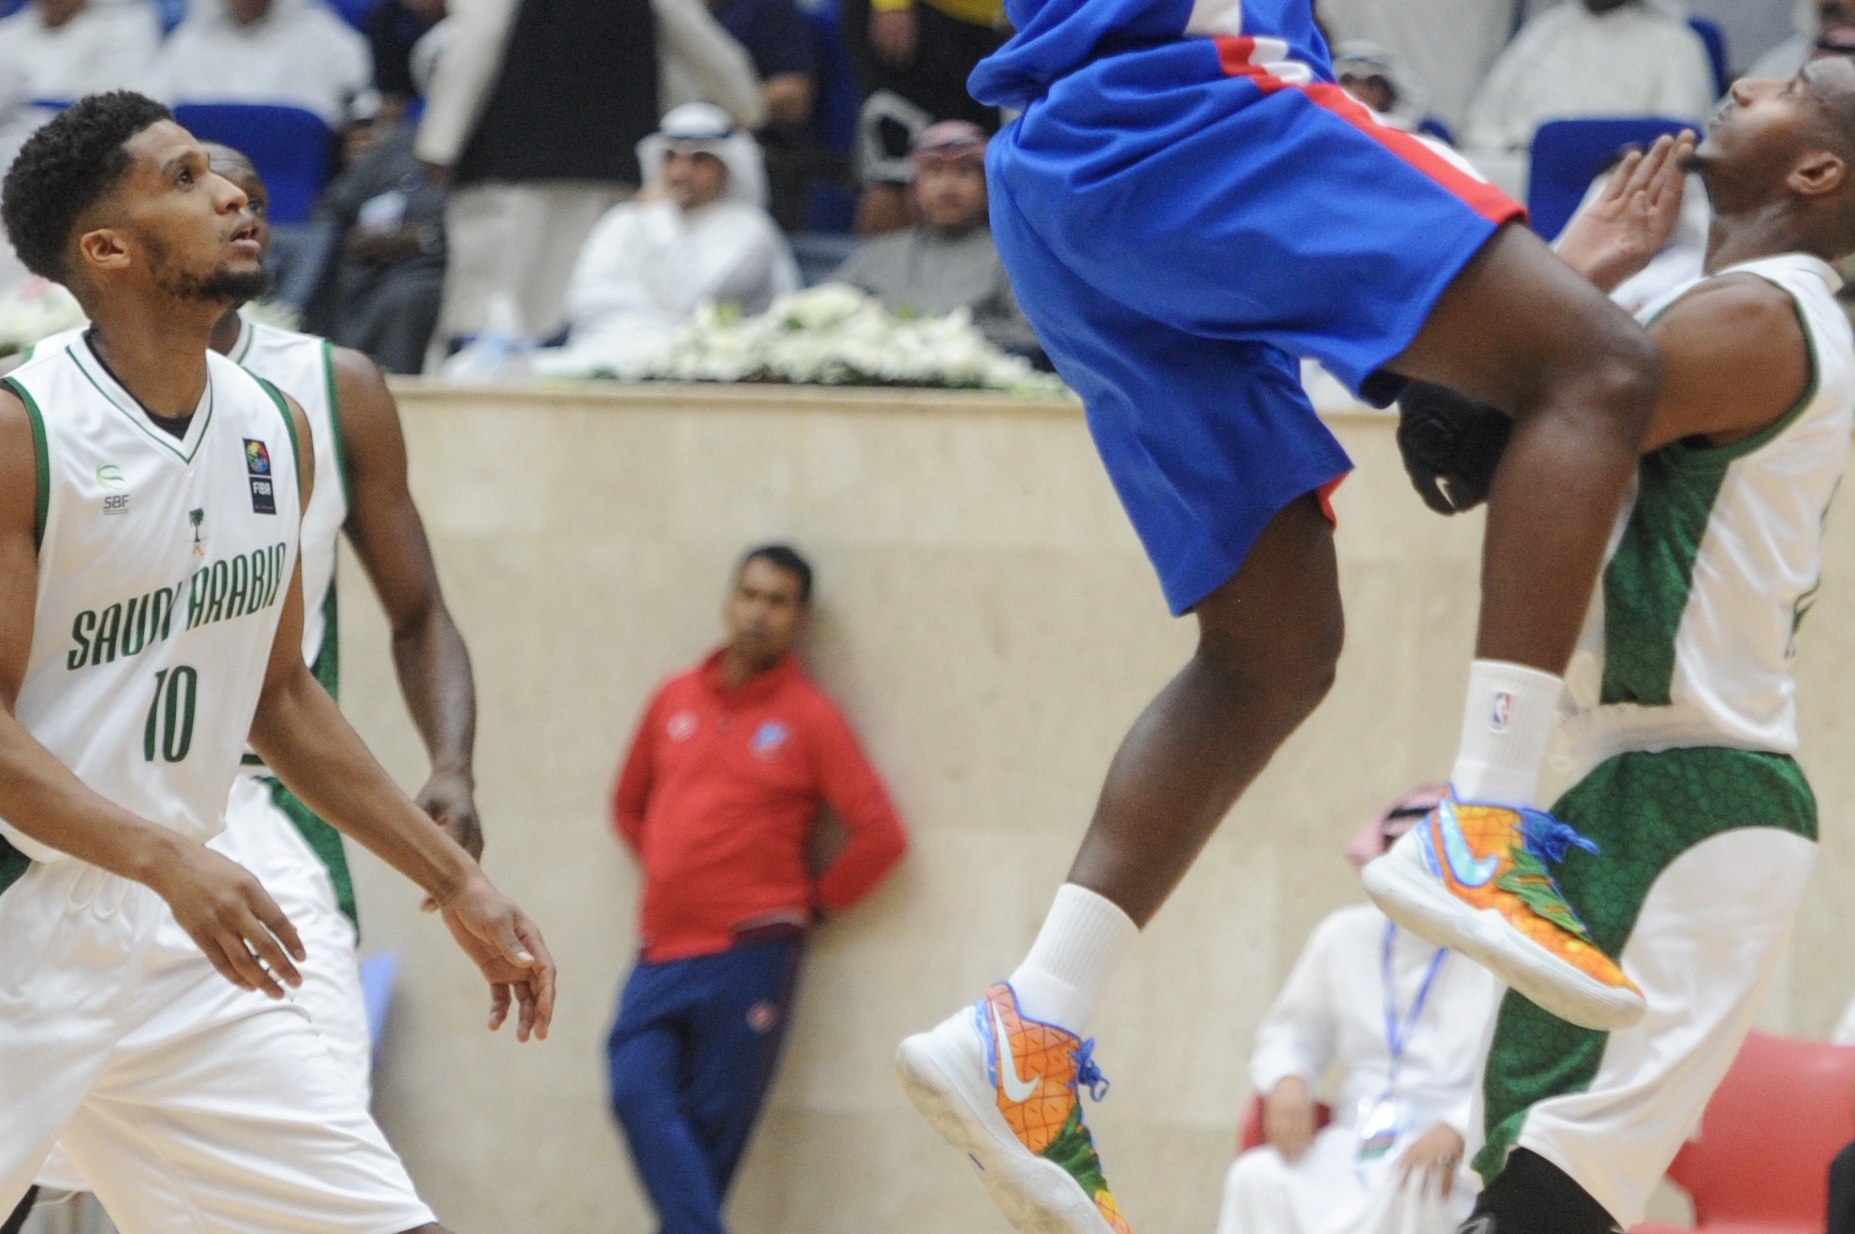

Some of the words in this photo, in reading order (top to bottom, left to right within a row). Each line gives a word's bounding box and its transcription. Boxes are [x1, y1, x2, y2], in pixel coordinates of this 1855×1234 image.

[103, 494, 130, 510] SBF
[185, 541, 288, 632] ARABIA
[143, 665, 198, 764] 10
